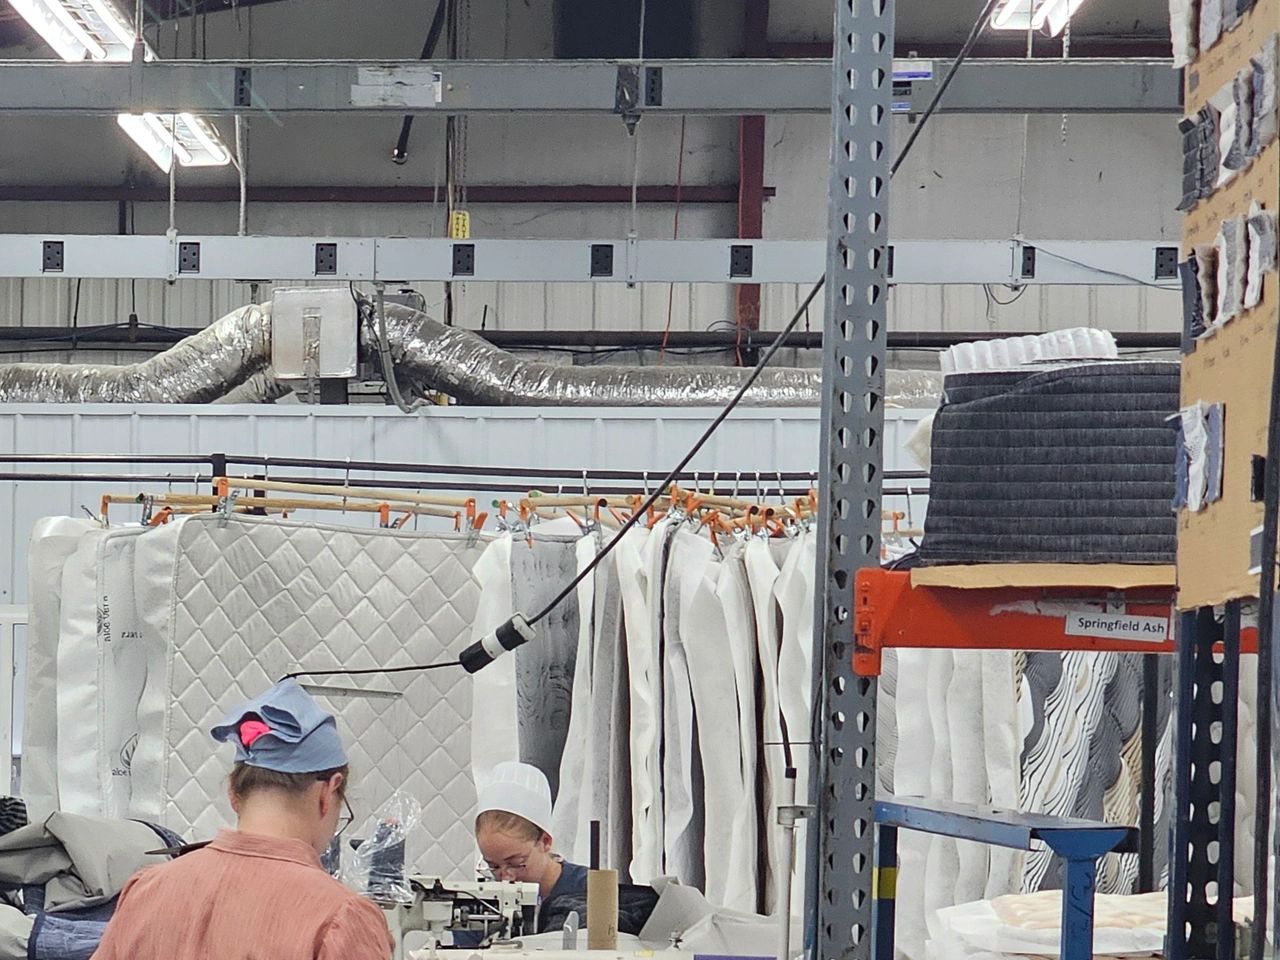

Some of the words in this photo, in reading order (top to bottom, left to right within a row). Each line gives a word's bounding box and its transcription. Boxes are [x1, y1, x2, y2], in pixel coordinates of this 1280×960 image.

[1078, 616, 1140, 632] Springfield
[1143, 622, 1165, 634] Ash
[112, 767, 127, 776] aloe
